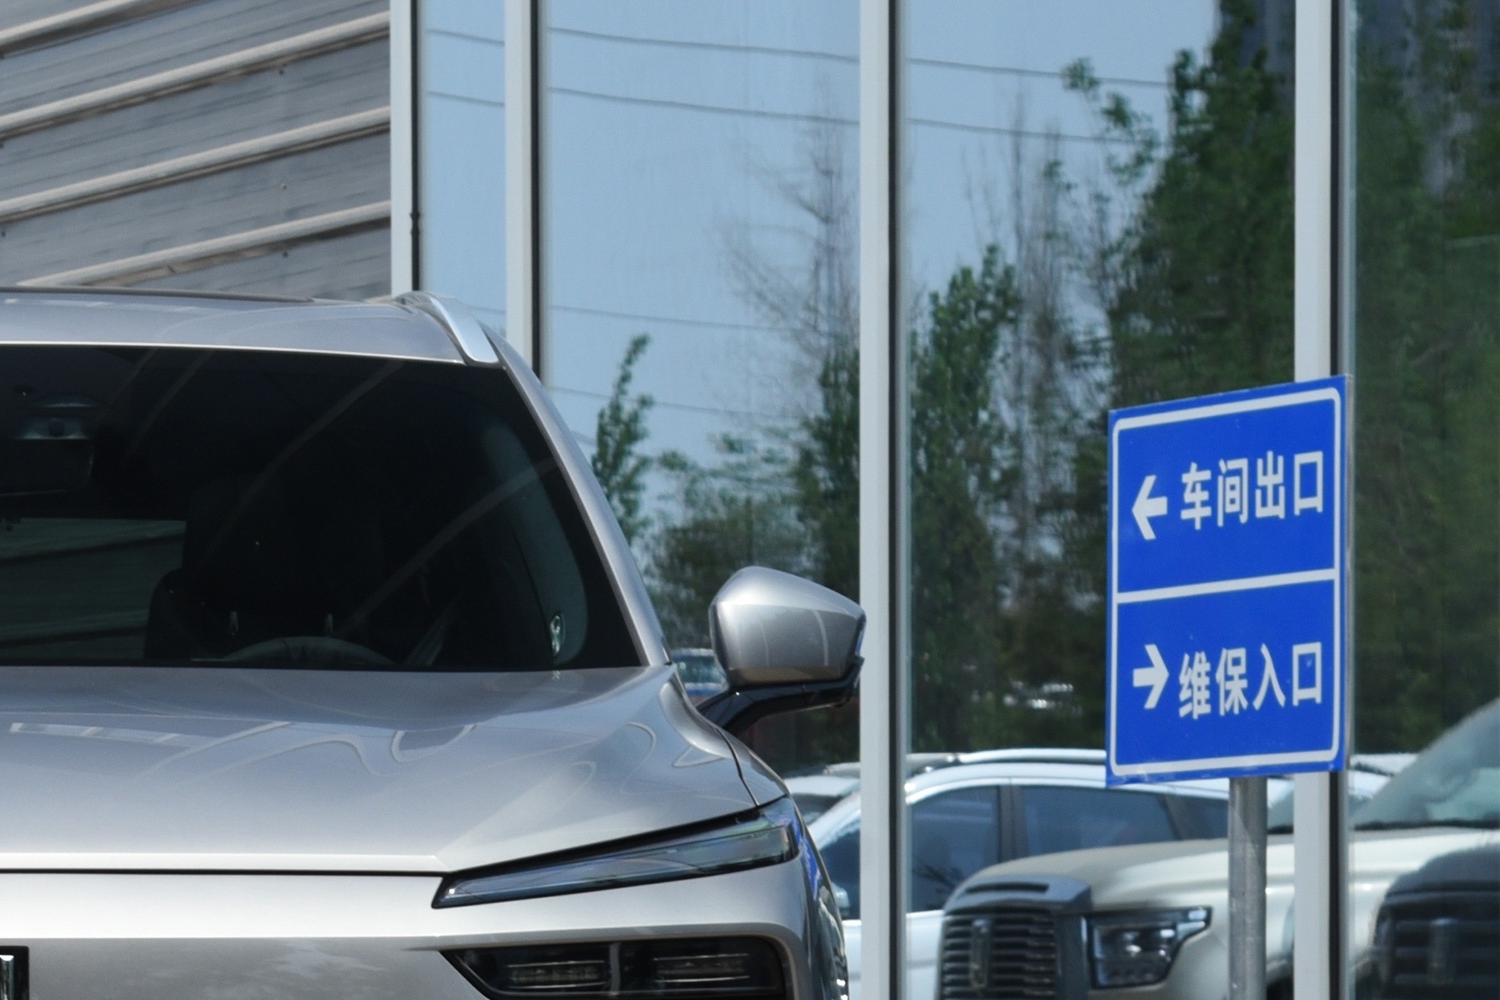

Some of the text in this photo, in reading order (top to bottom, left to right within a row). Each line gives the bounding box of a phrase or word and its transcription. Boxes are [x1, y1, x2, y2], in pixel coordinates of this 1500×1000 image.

[1180, 451, 1323, 530] 车间出口
[1179, 641, 1322, 719] 维保入口
